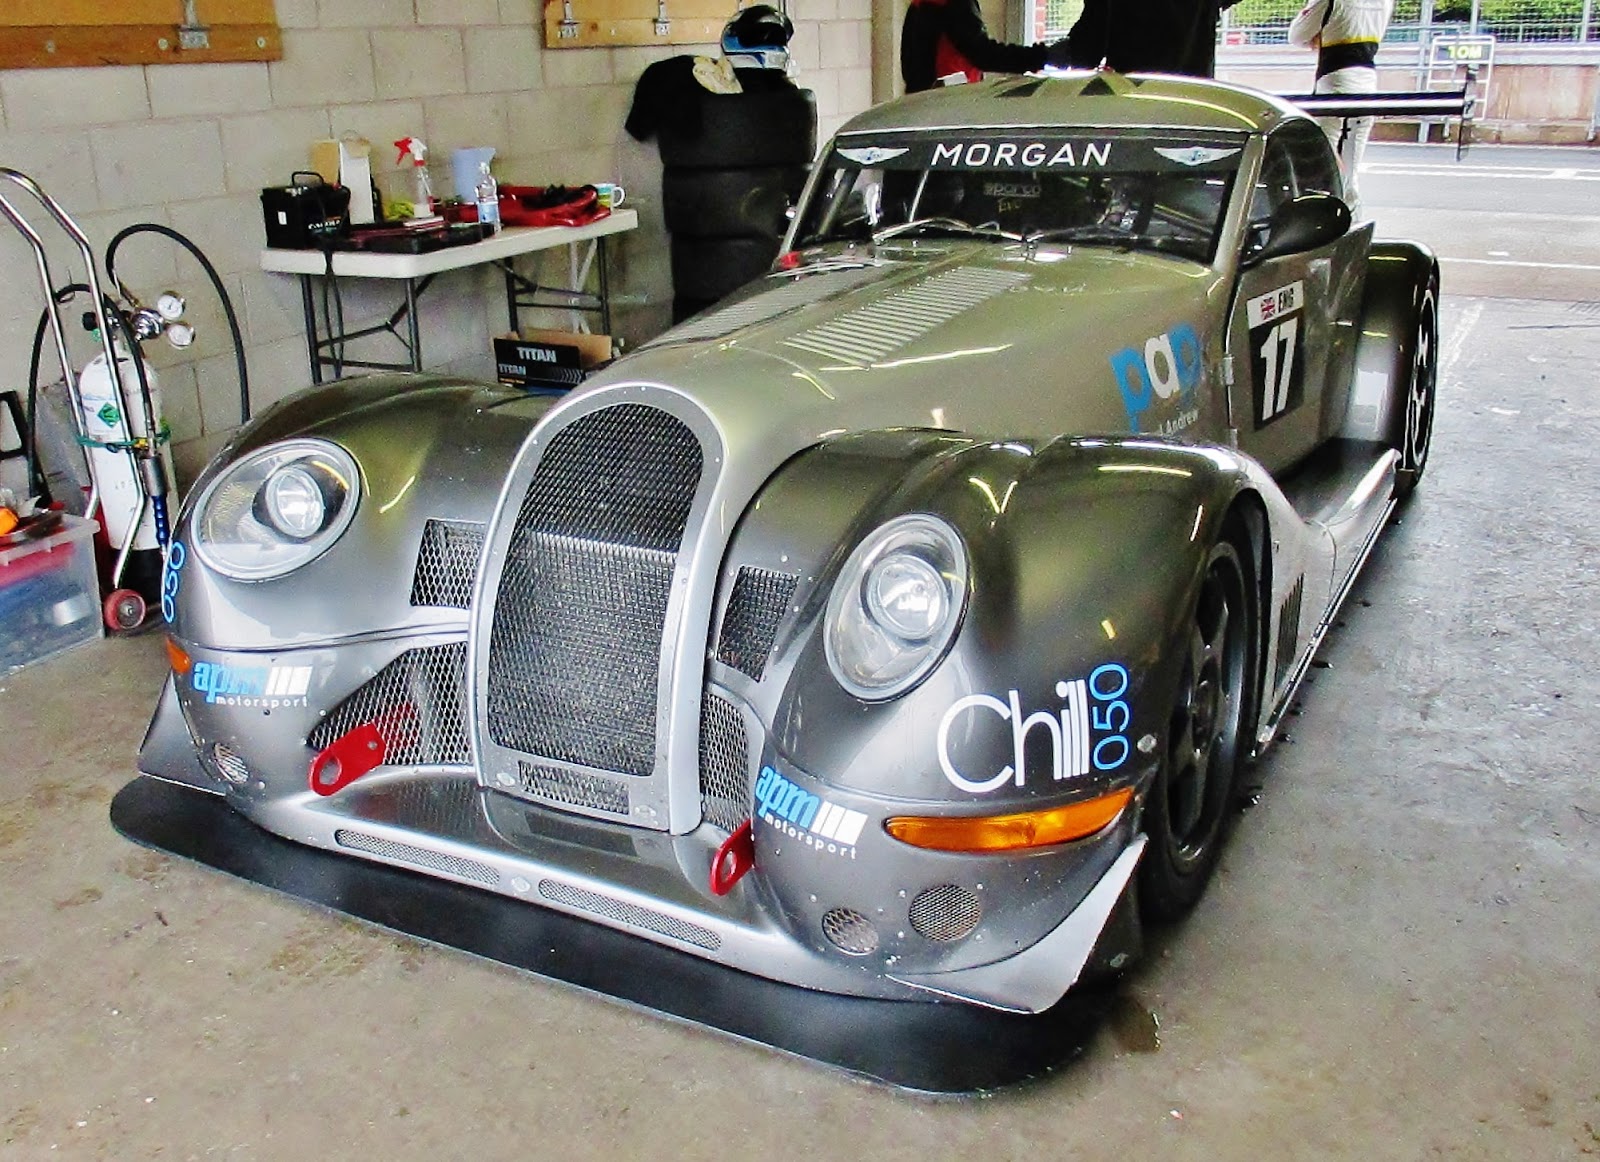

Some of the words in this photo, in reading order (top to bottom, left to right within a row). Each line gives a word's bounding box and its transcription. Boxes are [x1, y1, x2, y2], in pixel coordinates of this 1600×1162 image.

[931, 142, 1111, 167] MORGAN
[1278, 287, 1295, 312] ENG
[498, 363, 526, 376] TITAN
[516, 346, 557, 363] TITAN
[1260, 316, 1299, 422] 17
[1165, 407, 1200, 437] Andrew
[161, 541, 187, 624] 050
[192, 662, 270, 703] apm
[216, 695, 308, 709] motorsport
[937, 678, 1091, 794] Chill
[1088, 662, 1131, 771] 050
[755, 765, 821, 829] apm
[764, 811, 857, 860] motorsport
